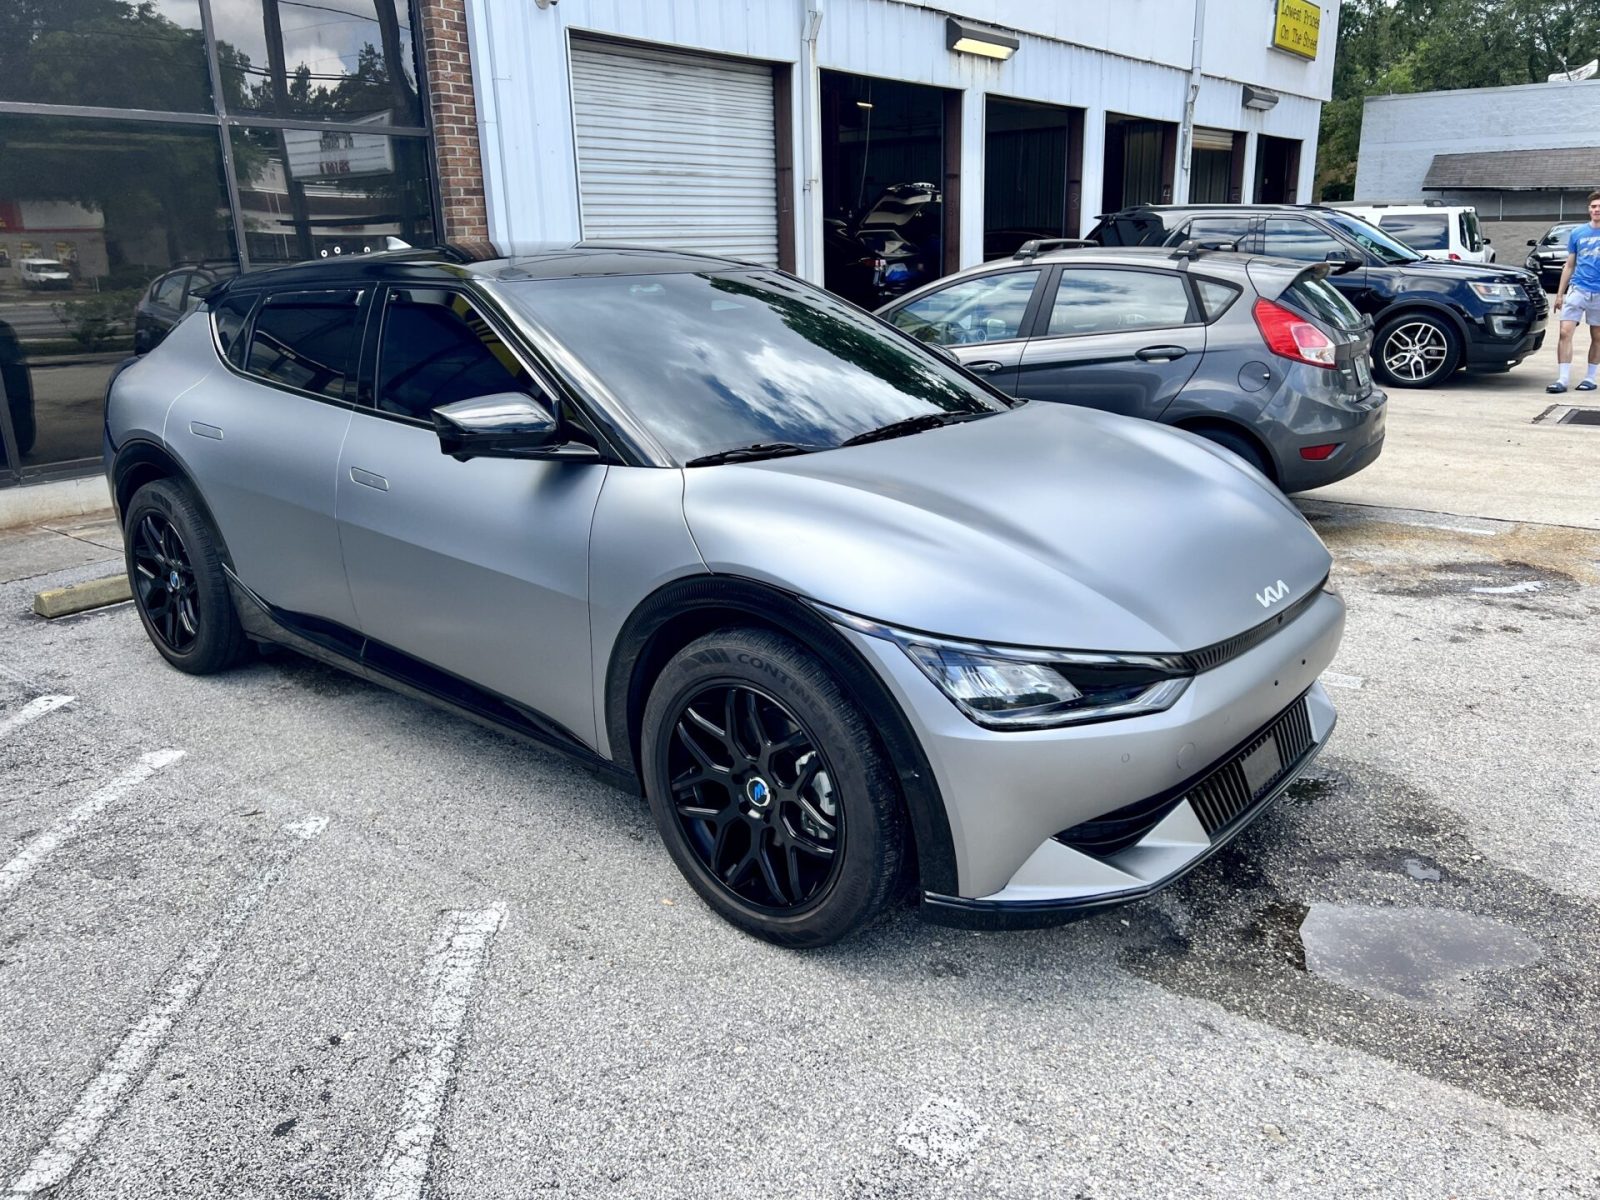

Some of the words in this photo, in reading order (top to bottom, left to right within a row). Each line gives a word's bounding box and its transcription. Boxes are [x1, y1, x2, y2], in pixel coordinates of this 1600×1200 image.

[1281, 0, 1301, 21] Lowest
[1281, 25, 1289, 40] On
[1292, 28, 1302, 45] The
[1255, 579, 1290, 608] KIA
